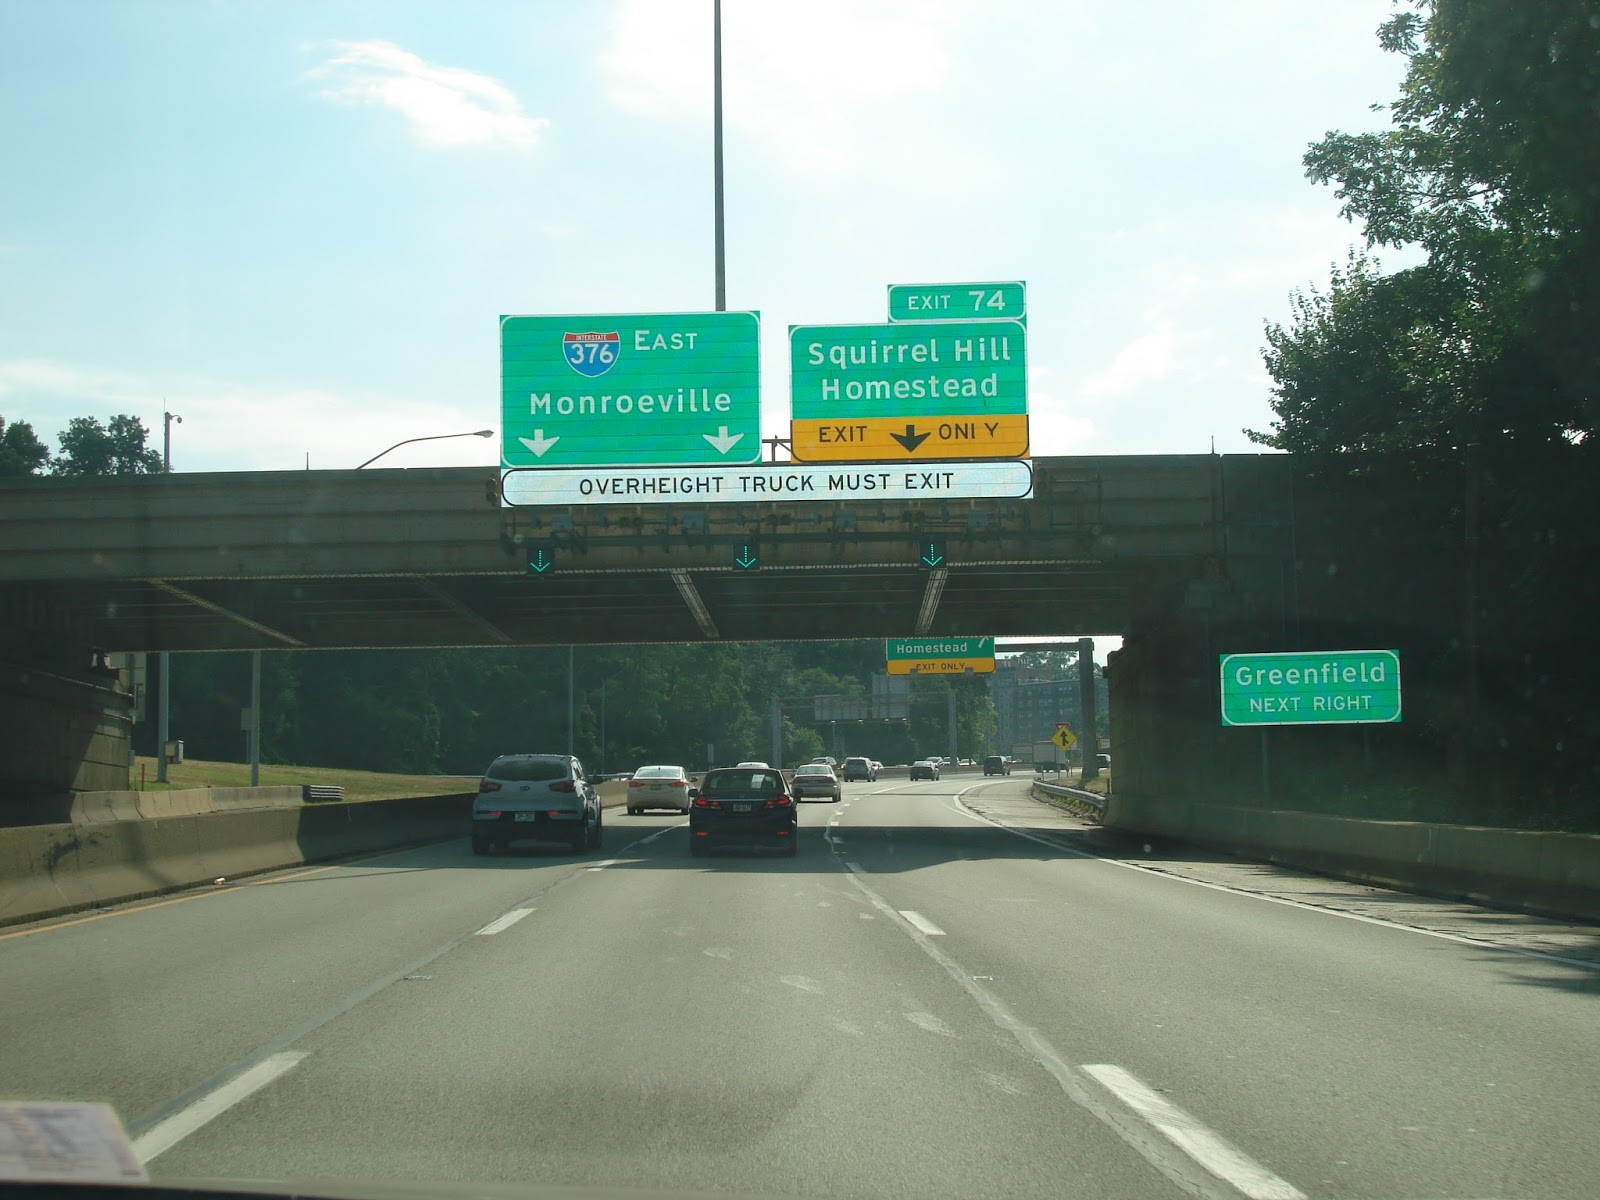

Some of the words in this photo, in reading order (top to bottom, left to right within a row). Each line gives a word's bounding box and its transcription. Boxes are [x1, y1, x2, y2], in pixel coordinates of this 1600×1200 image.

[908, 295, 951, 310] EXIT
[968, 290, 1006, 312] 74
[634, 329, 698, 351] EAST
[570, 343, 614, 364] 376
[808, 338, 939, 370] Squirrel
[955, 336, 1011, 361] Hill
[821, 372, 998, 401] Homestead
[530, 388, 731, 415] Monroeville
[819, 425, 868, 443] EXIT
[579, 476, 724, 496] OVERHEIGHT
[739, 474, 815, 493] TRUCK
[828, 473, 891, 491] MUST
[904, 472, 954, 489] EXIT
[896, 642, 968, 654] Homestead
[916, 663, 937, 671] EXIT
[940, 662, 966, 671] ONLY
[1235, 661, 1386, 686] Greenfield
[1250, 697, 1300, 713] NEXT
[1313, 695, 1372, 711] RIGHT
